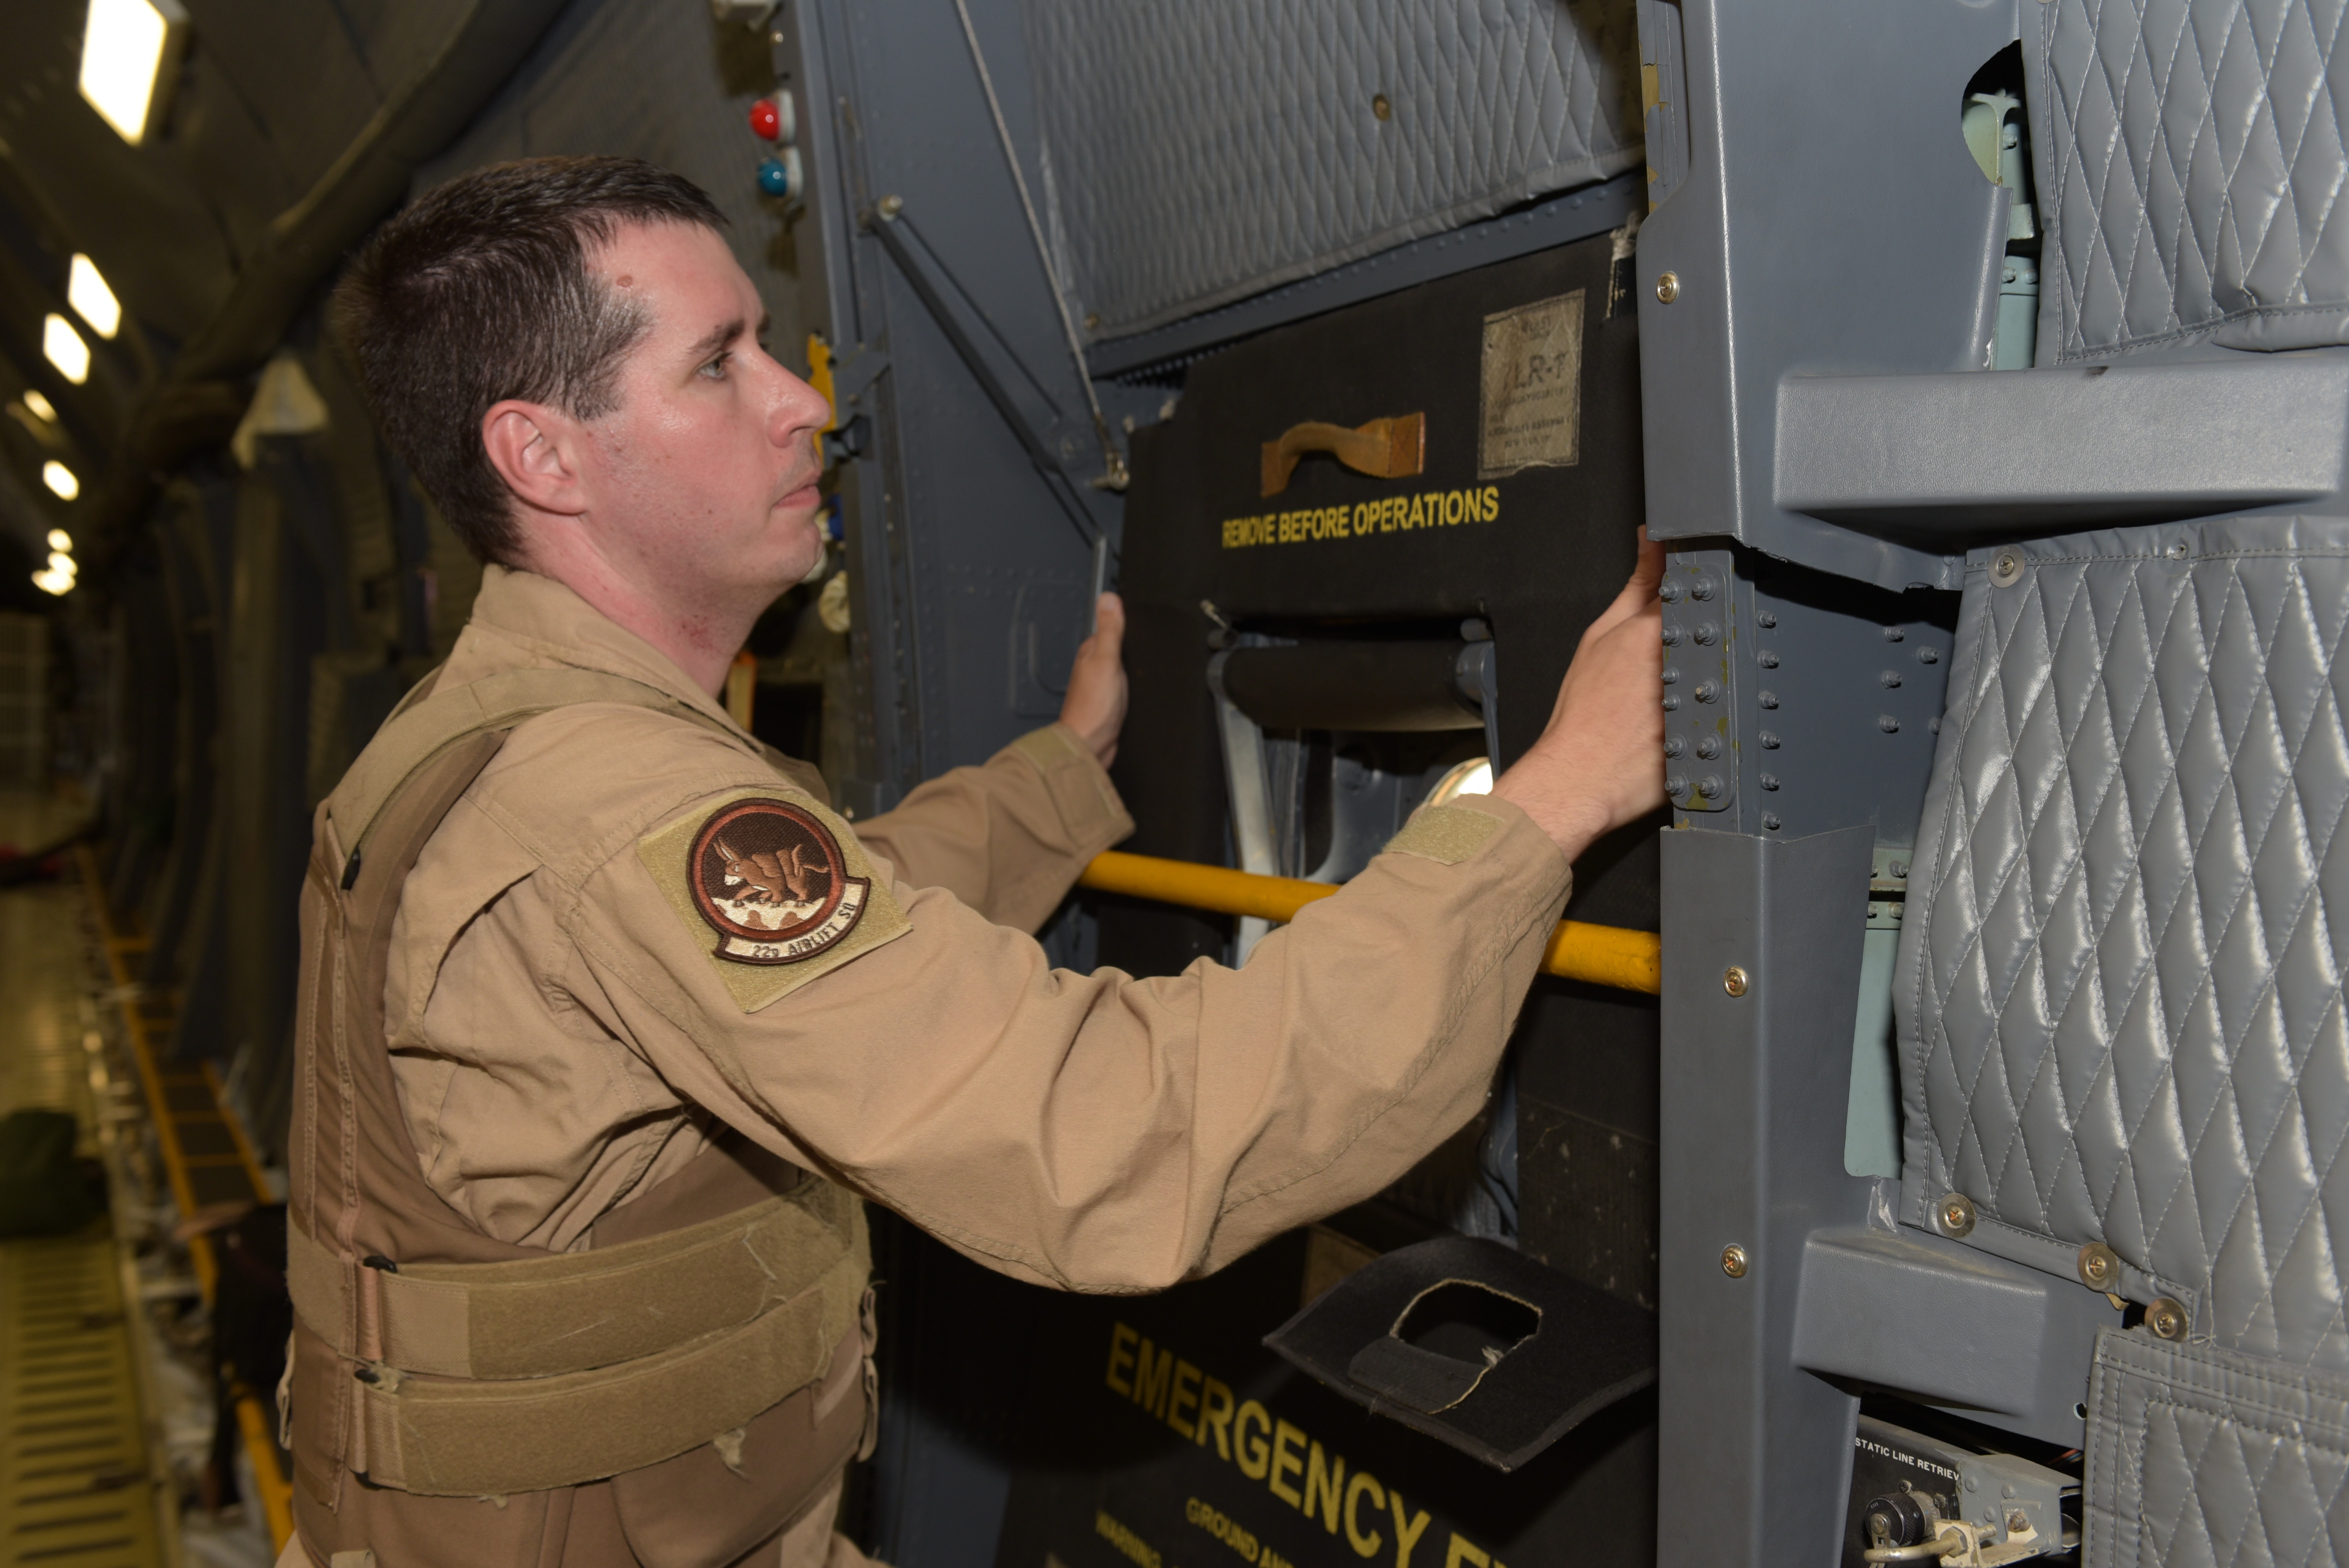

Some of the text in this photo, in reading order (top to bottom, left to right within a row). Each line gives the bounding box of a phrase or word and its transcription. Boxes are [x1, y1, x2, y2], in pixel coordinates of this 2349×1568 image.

[1222, 486, 1499, 549] REMOVE BEFORE OPERATIONS
[788, 921, 839, 955] AIRLIFT
[1107, 1322, 1432, 1568] EMERGENCY
[1855, 1437, 1959, 1481] STATIC LINE RETRIEV
[1095, 1510, 1162, 1568] WARNING
[1185, 1497, 1260, 1563] GROUND
